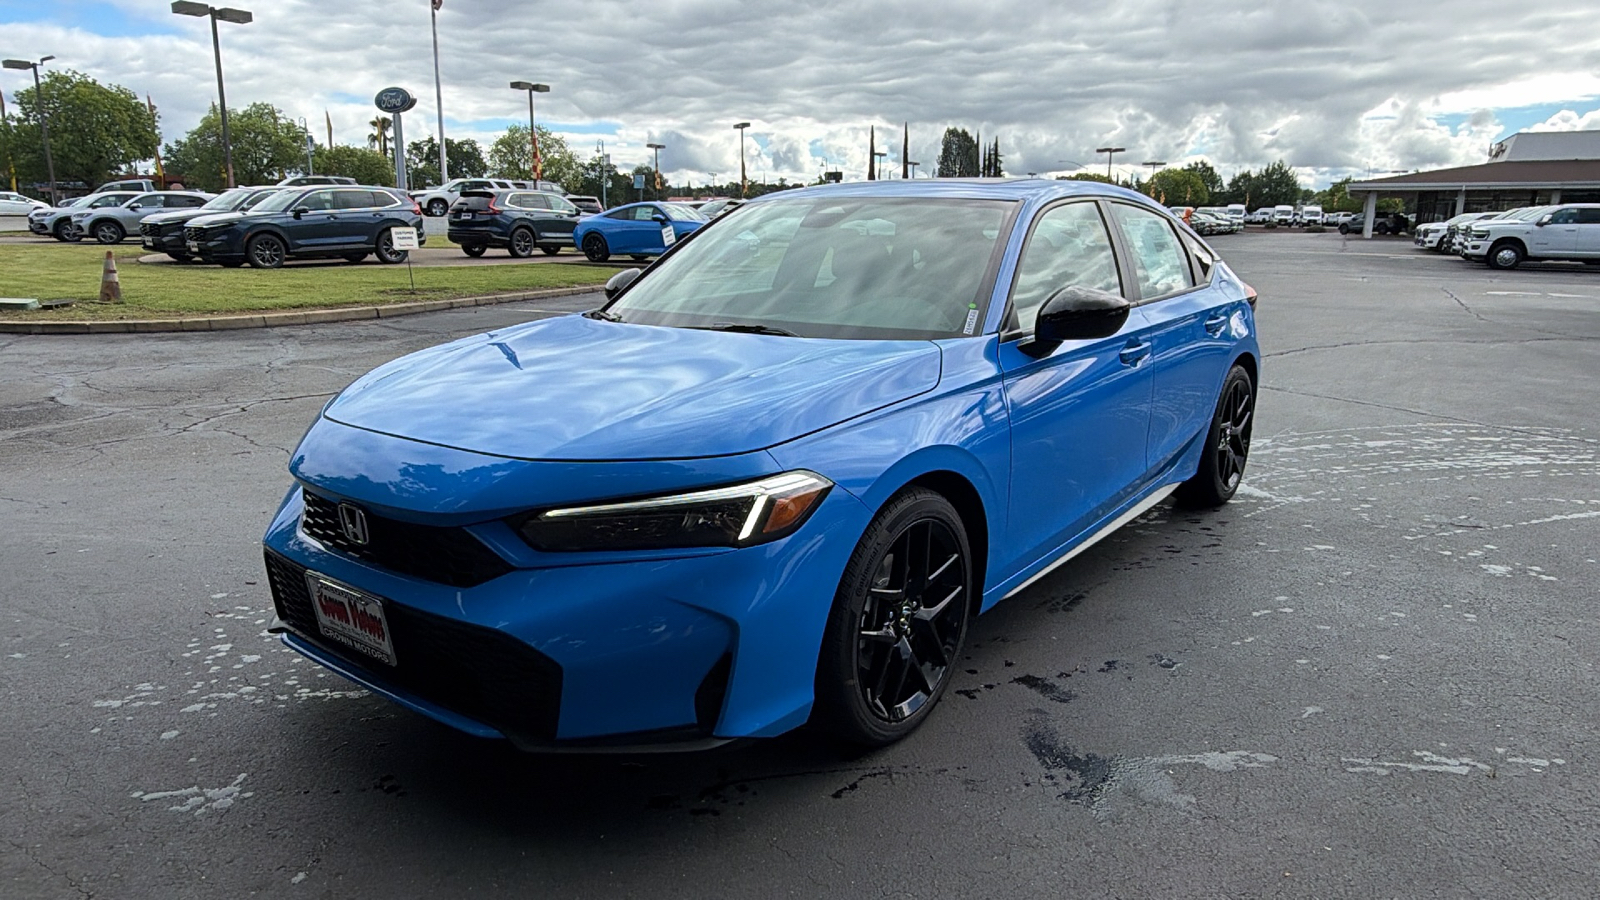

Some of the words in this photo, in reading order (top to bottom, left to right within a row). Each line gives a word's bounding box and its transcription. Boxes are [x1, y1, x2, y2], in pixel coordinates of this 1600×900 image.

[381, 92, 403, 108] Ford
[856, 546, 879, 597] Continental
[317, 590, 350, 626] Crown
[348, 597, 386, 643] Motors
[323, 627, 354, 647] CROWN
[354, 640, 390, 663] MOTORS
